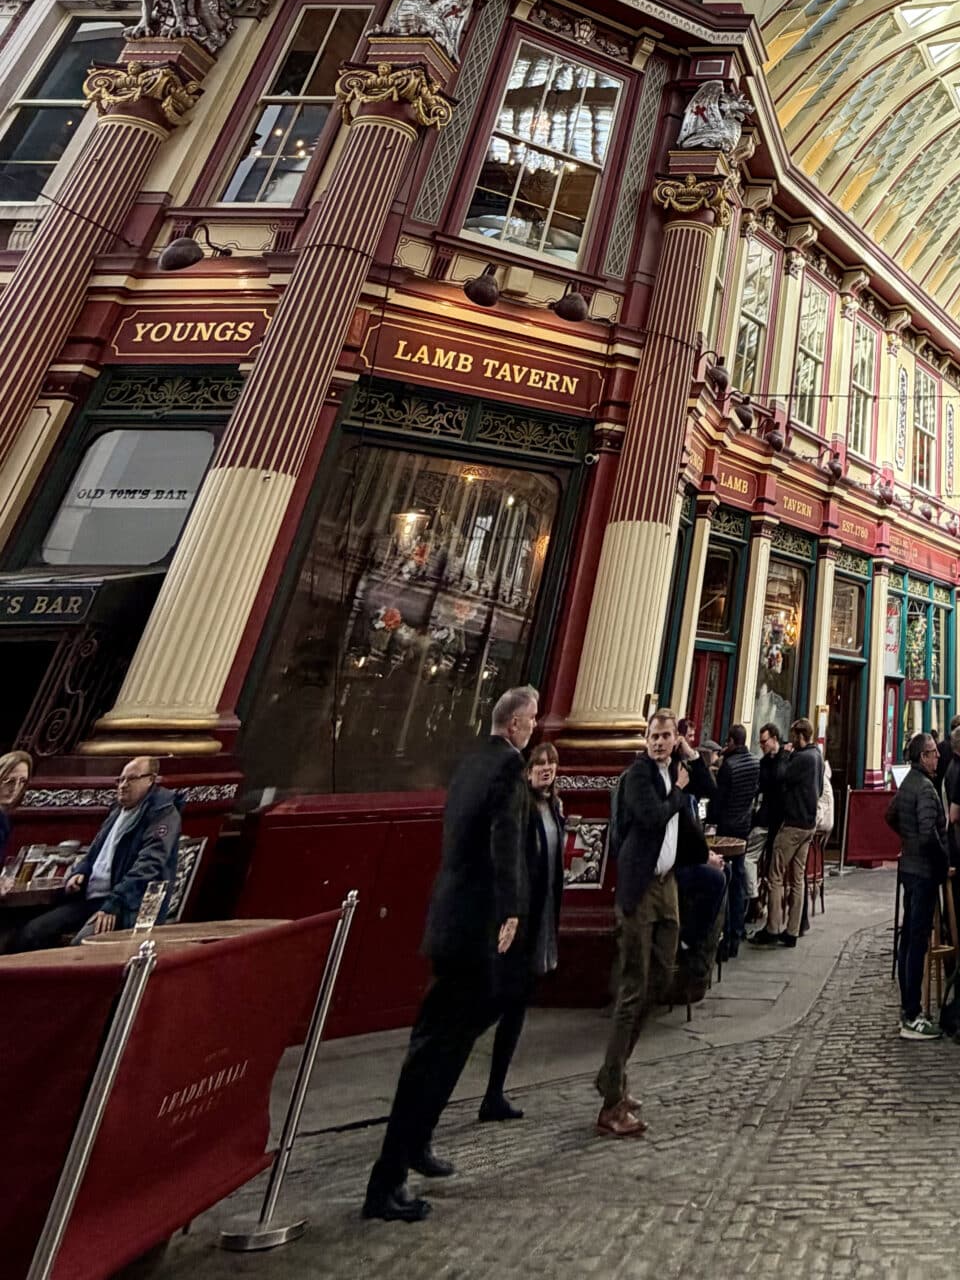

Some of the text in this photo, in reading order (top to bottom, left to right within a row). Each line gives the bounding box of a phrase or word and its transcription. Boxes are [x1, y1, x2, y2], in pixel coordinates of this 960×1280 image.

[132, 322, 255, 342] YOUNGS
[393, 340, 580, 396] LAMB TAVERN
[76, 488, 188, 501] OLD TOM'S BAR
[719, 472, 749, 494] LAMB
[783, 495, 813, 518] TAVERN
[30, 595, 83, 614] BAR
